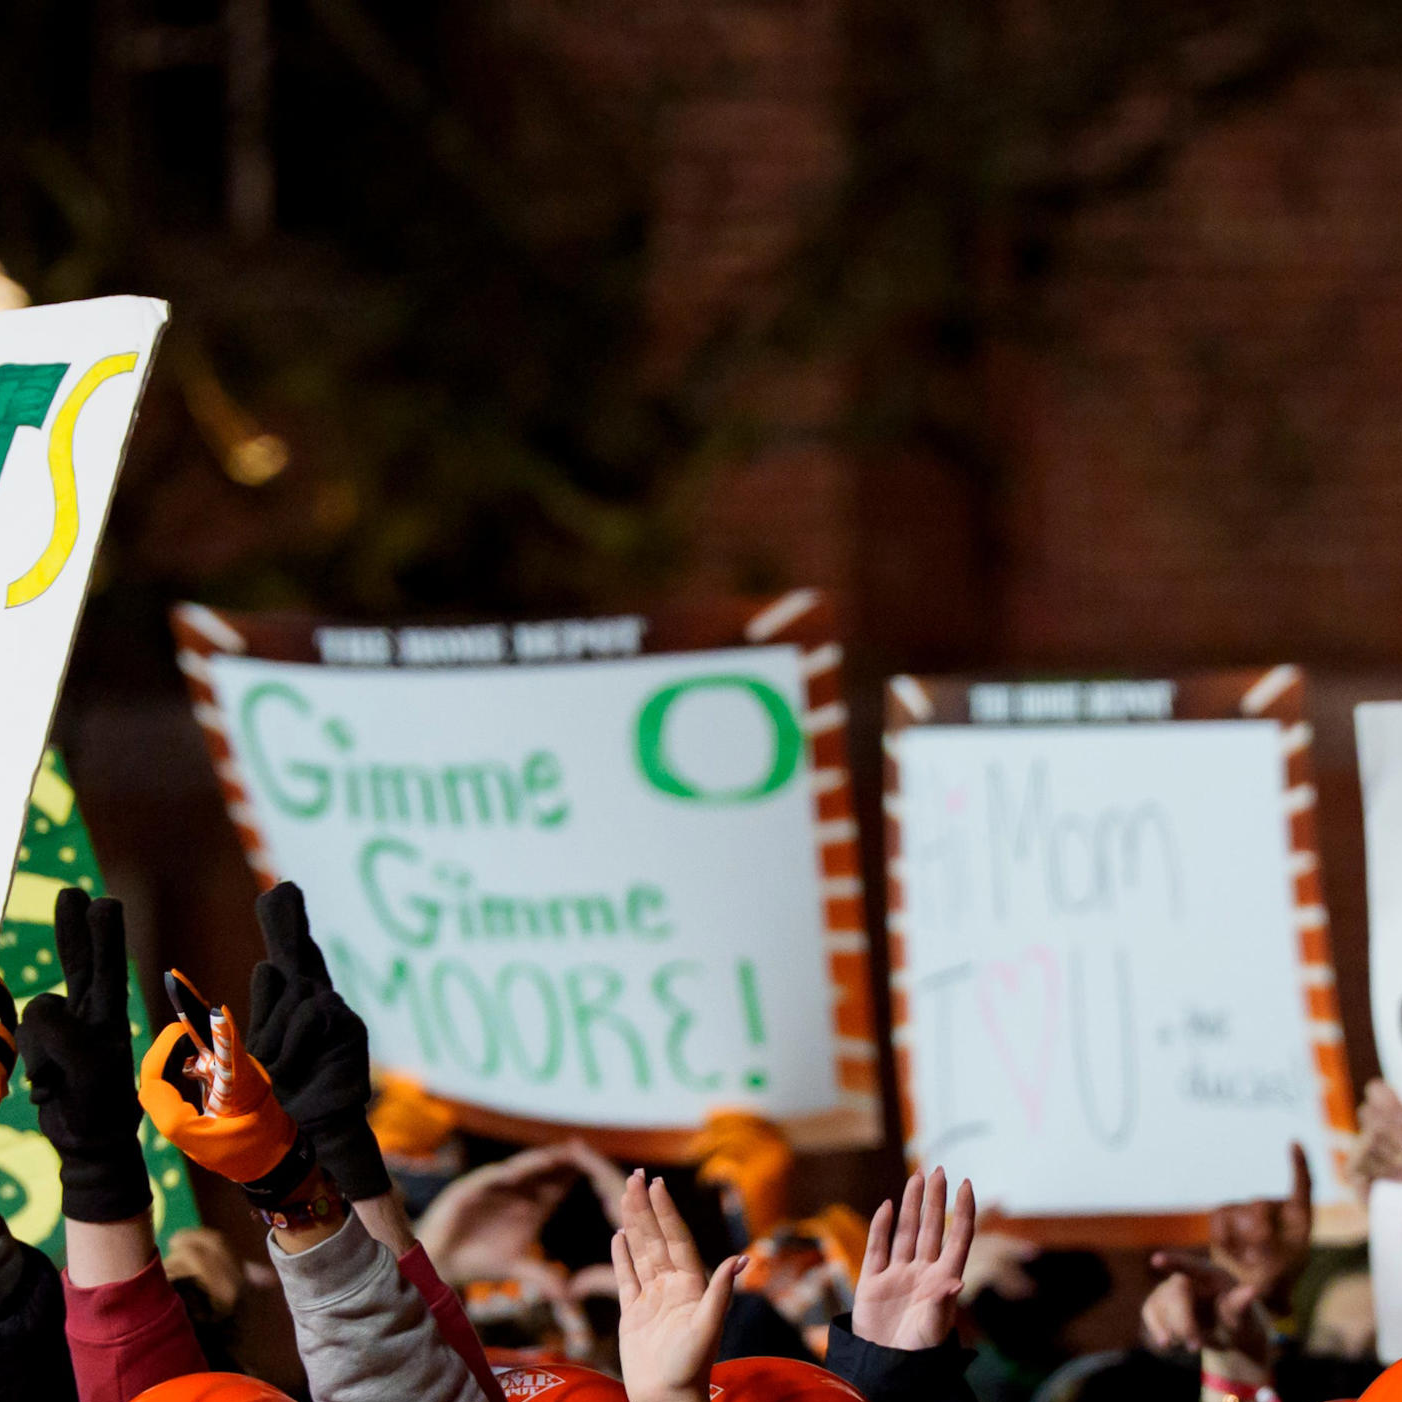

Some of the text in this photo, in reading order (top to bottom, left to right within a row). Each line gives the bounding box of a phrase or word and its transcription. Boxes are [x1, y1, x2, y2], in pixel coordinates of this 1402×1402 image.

[240, 681, 571, 828] Gimme
[633, 673, 804, 805] O
[358, 837, 672, 948] Gimme
[329, 938, 770, 1091] MOORE!
